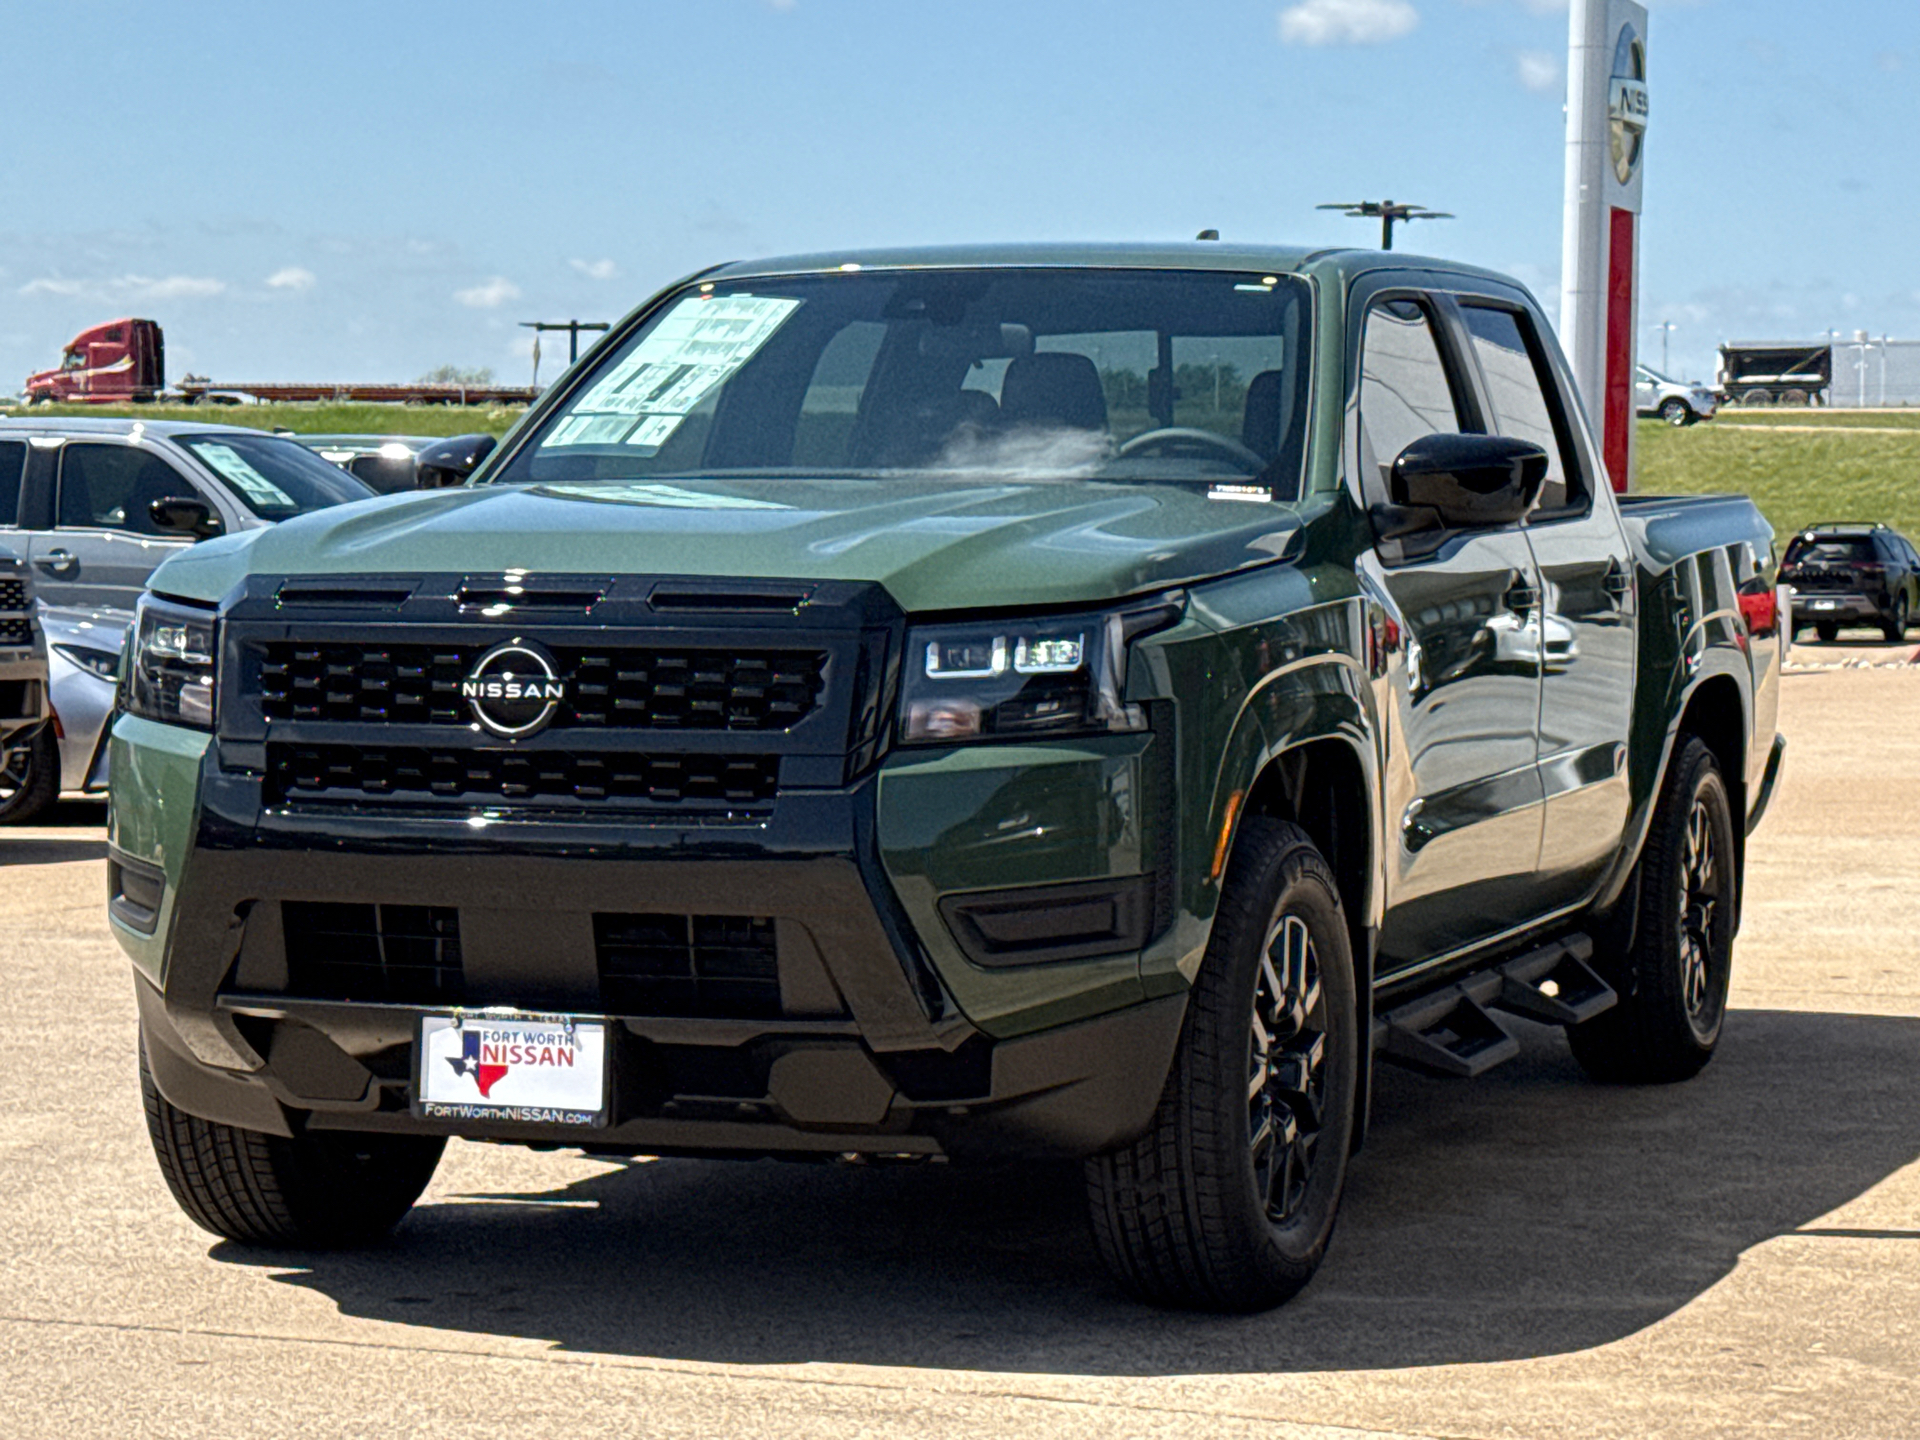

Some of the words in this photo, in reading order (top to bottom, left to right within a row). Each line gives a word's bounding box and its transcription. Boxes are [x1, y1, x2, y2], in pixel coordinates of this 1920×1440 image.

[462, 682, 564, 698] NISSAN
[483, 1030, 520, 1043] FORT
[523, 1032, 574, 1046] WORTH
[483, 1044, 574, 1067] NISSAN
